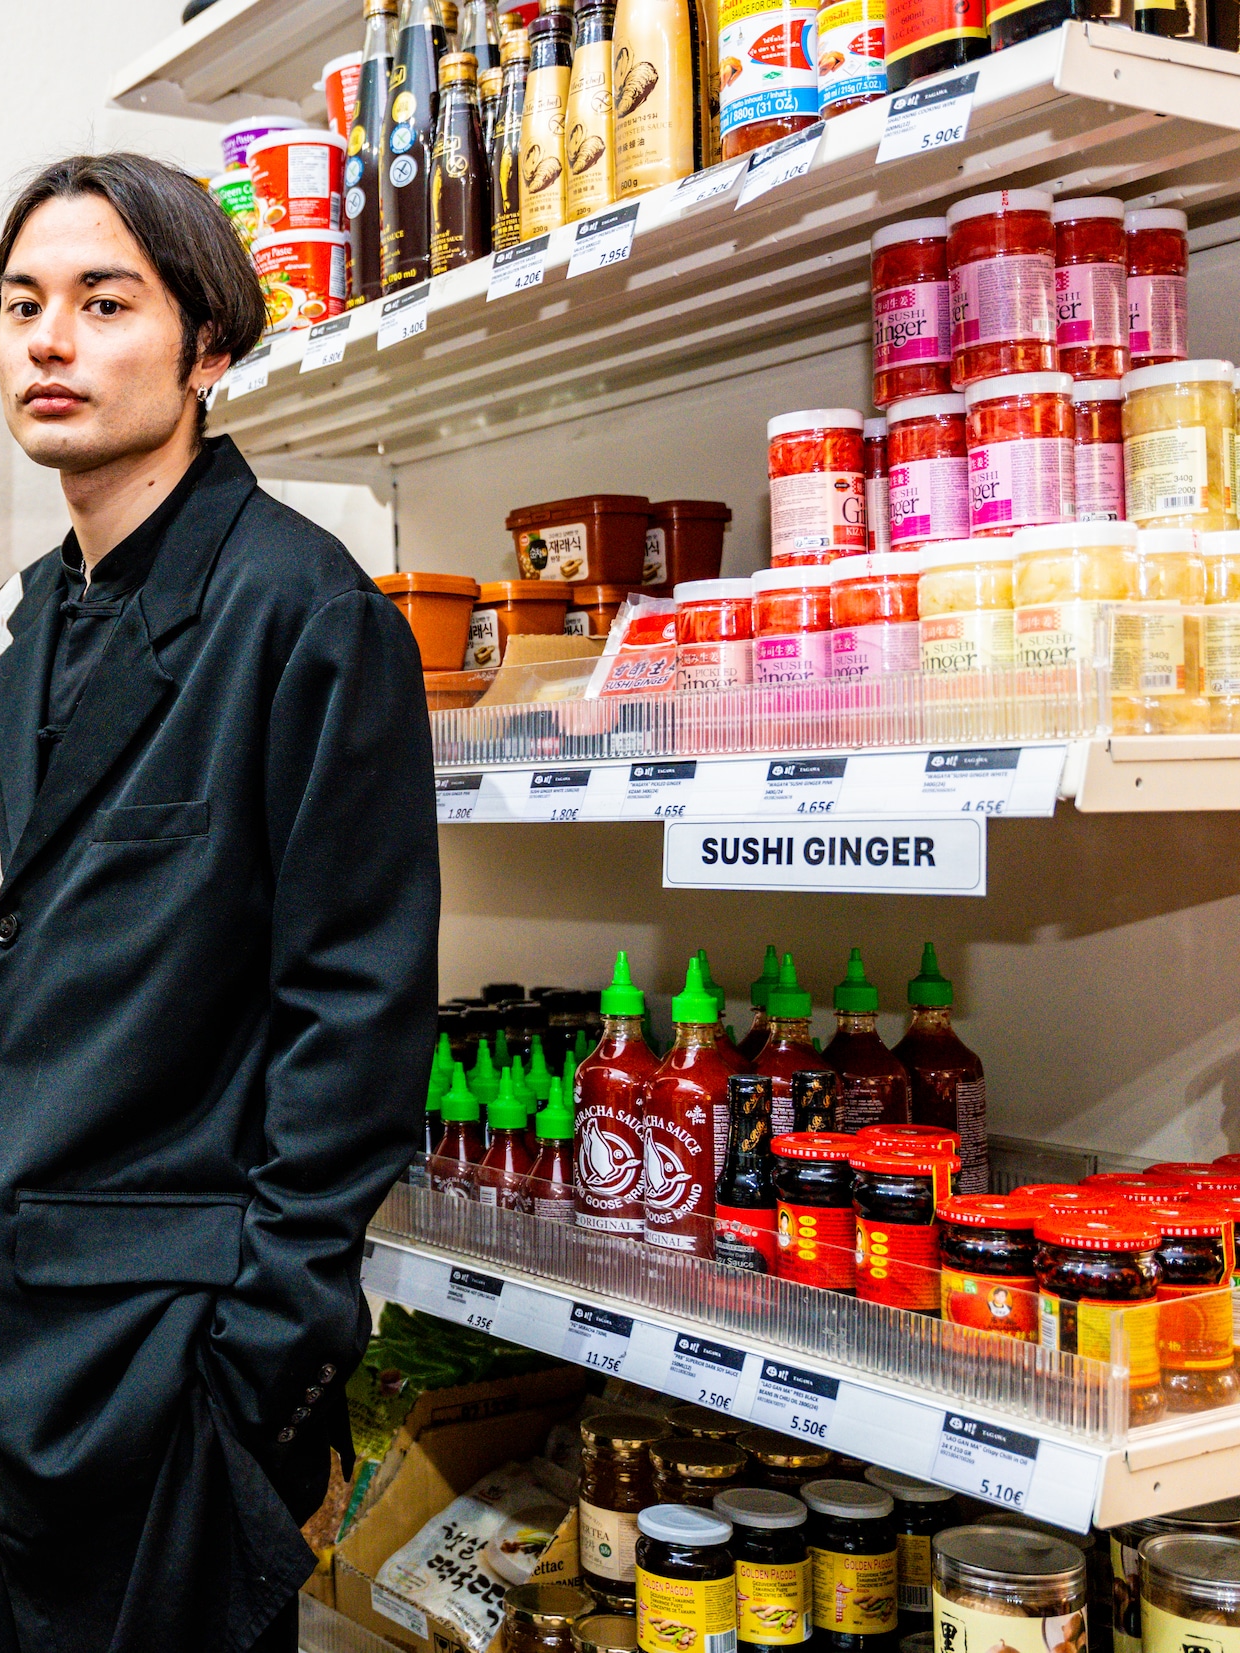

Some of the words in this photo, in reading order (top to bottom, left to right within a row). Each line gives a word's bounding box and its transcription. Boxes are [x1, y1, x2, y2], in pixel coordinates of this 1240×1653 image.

[732, 4, 751, 19] SAUCE
[751, 2, 766, 13] FOR
[901, 11, 925, 26] 600ml
[841, 85, 855, 96] 215g
[734, 108, 754, 123] 880g
[756, 102, 773, 116] (31
[918, 104, 941, 117] COOKING
[942, 99, 957, 109] WINE
[921, 125, 963, 149] 5.90€
[771, 161, 809, 186] 4.10€
[696, 180, 734, 200] 6.20€
[576, 205, 587, 216] 230
[533, 225, 543, 234] 230
[271, 245, 293, 257] Paste
[599, 246, 629, 266] 7.95€
[515, 270, 542, 288] 4.20€
[888, 308, 926, 322] SUSHI
[402, 320, 425, 338] 3.40€
[322, 351, 343, 366] 6.80€
[970, 470, 999, 483] SUSHI
[1173, 474, 1193, 484] 340g
[1177, 486, 1197, 496] 200g
[548, 537, 582, 554] 재래식
[1028, 633, 1073, 647] SUSHI
[933, 640, 976, 655] SUSHI
[835, 653, 868, 666] SUSHI
[1148, 651, 1169, 661] 340g
[695, 667, 738, 678] PICKLED
[773, 660, 814, 671] SUSHI
[1151, 663, 1173, 674] 200g
[604, 678, 633, 692] SUSHI
[634, 675, 669, 689] GINGER
[448, 808, 473, 819] 1.80€
[654, 805, 686, 817] 4.65€
[797, 801, 835, 814] 4.65€
[962, 800, 1006, 814] 4.65€
[551, 809, 579, 820] 1.80€
[701, 836, 793, 866] SUSHI
[803, 836, 936, 867] GINGER
[685, 1109, 707, 1120] Gluten
[691, 1117, 706, 1126] Free
[666, 1120, 702, 1156] SAUCE
[586, 1196, 622, 1210] GOOSE
[674, 1183, 702, 1220] BRAND
[579, 1217, 634, 1231] ORIGINAL
[727, 1257, 754, 1269] Sauce
[467, 1314, 494, 1330] 4.35€
[702, 1347, 722, 1358] TAGAWA
[586, 1351, 622, 1373] 11.75€
[685, 1356, 705, 1367] SUPERIOR
[704, 1362, 716, 1371] DARK
[725, 1368, 739, 1378] SAUCE
[792, 1375, 814, 1387] TAGAWA
[698, 1389, 732, 1410] 2.50€
[759, 1389, 771, 1398] BEANS
[772, 1383, 782, 1392] GAN
[793, 1389, 803, 1398] PRES
[803, 1393, 819, 1402] BLACK
[790, 1415, 827, 1438] 5.50€
[982, 1430, 1007, 1442] TAGAWA
[943, 1433, 956, 1444] "LAO
[957, 1437, 969, 1447] GAN
[970, 1441, 982, 1451] MA"
[982, 1446, 998, 1458] Crispy
[999, 1450, 1013, 1461] Chilli
[1019, 1457, 1028, 1466] Oil
[979, 1478, 1024, 1506] 5.10€
[844, 1558, 873, 1571] GOLDEN
[740, 1565, 769, 1580] GOLDEN
[770, 1569, 797, 1581] PAGODA
[642, 1574, 665, 1596] GOLDEN
[665, 1582, 695, 1598] PAGODA
